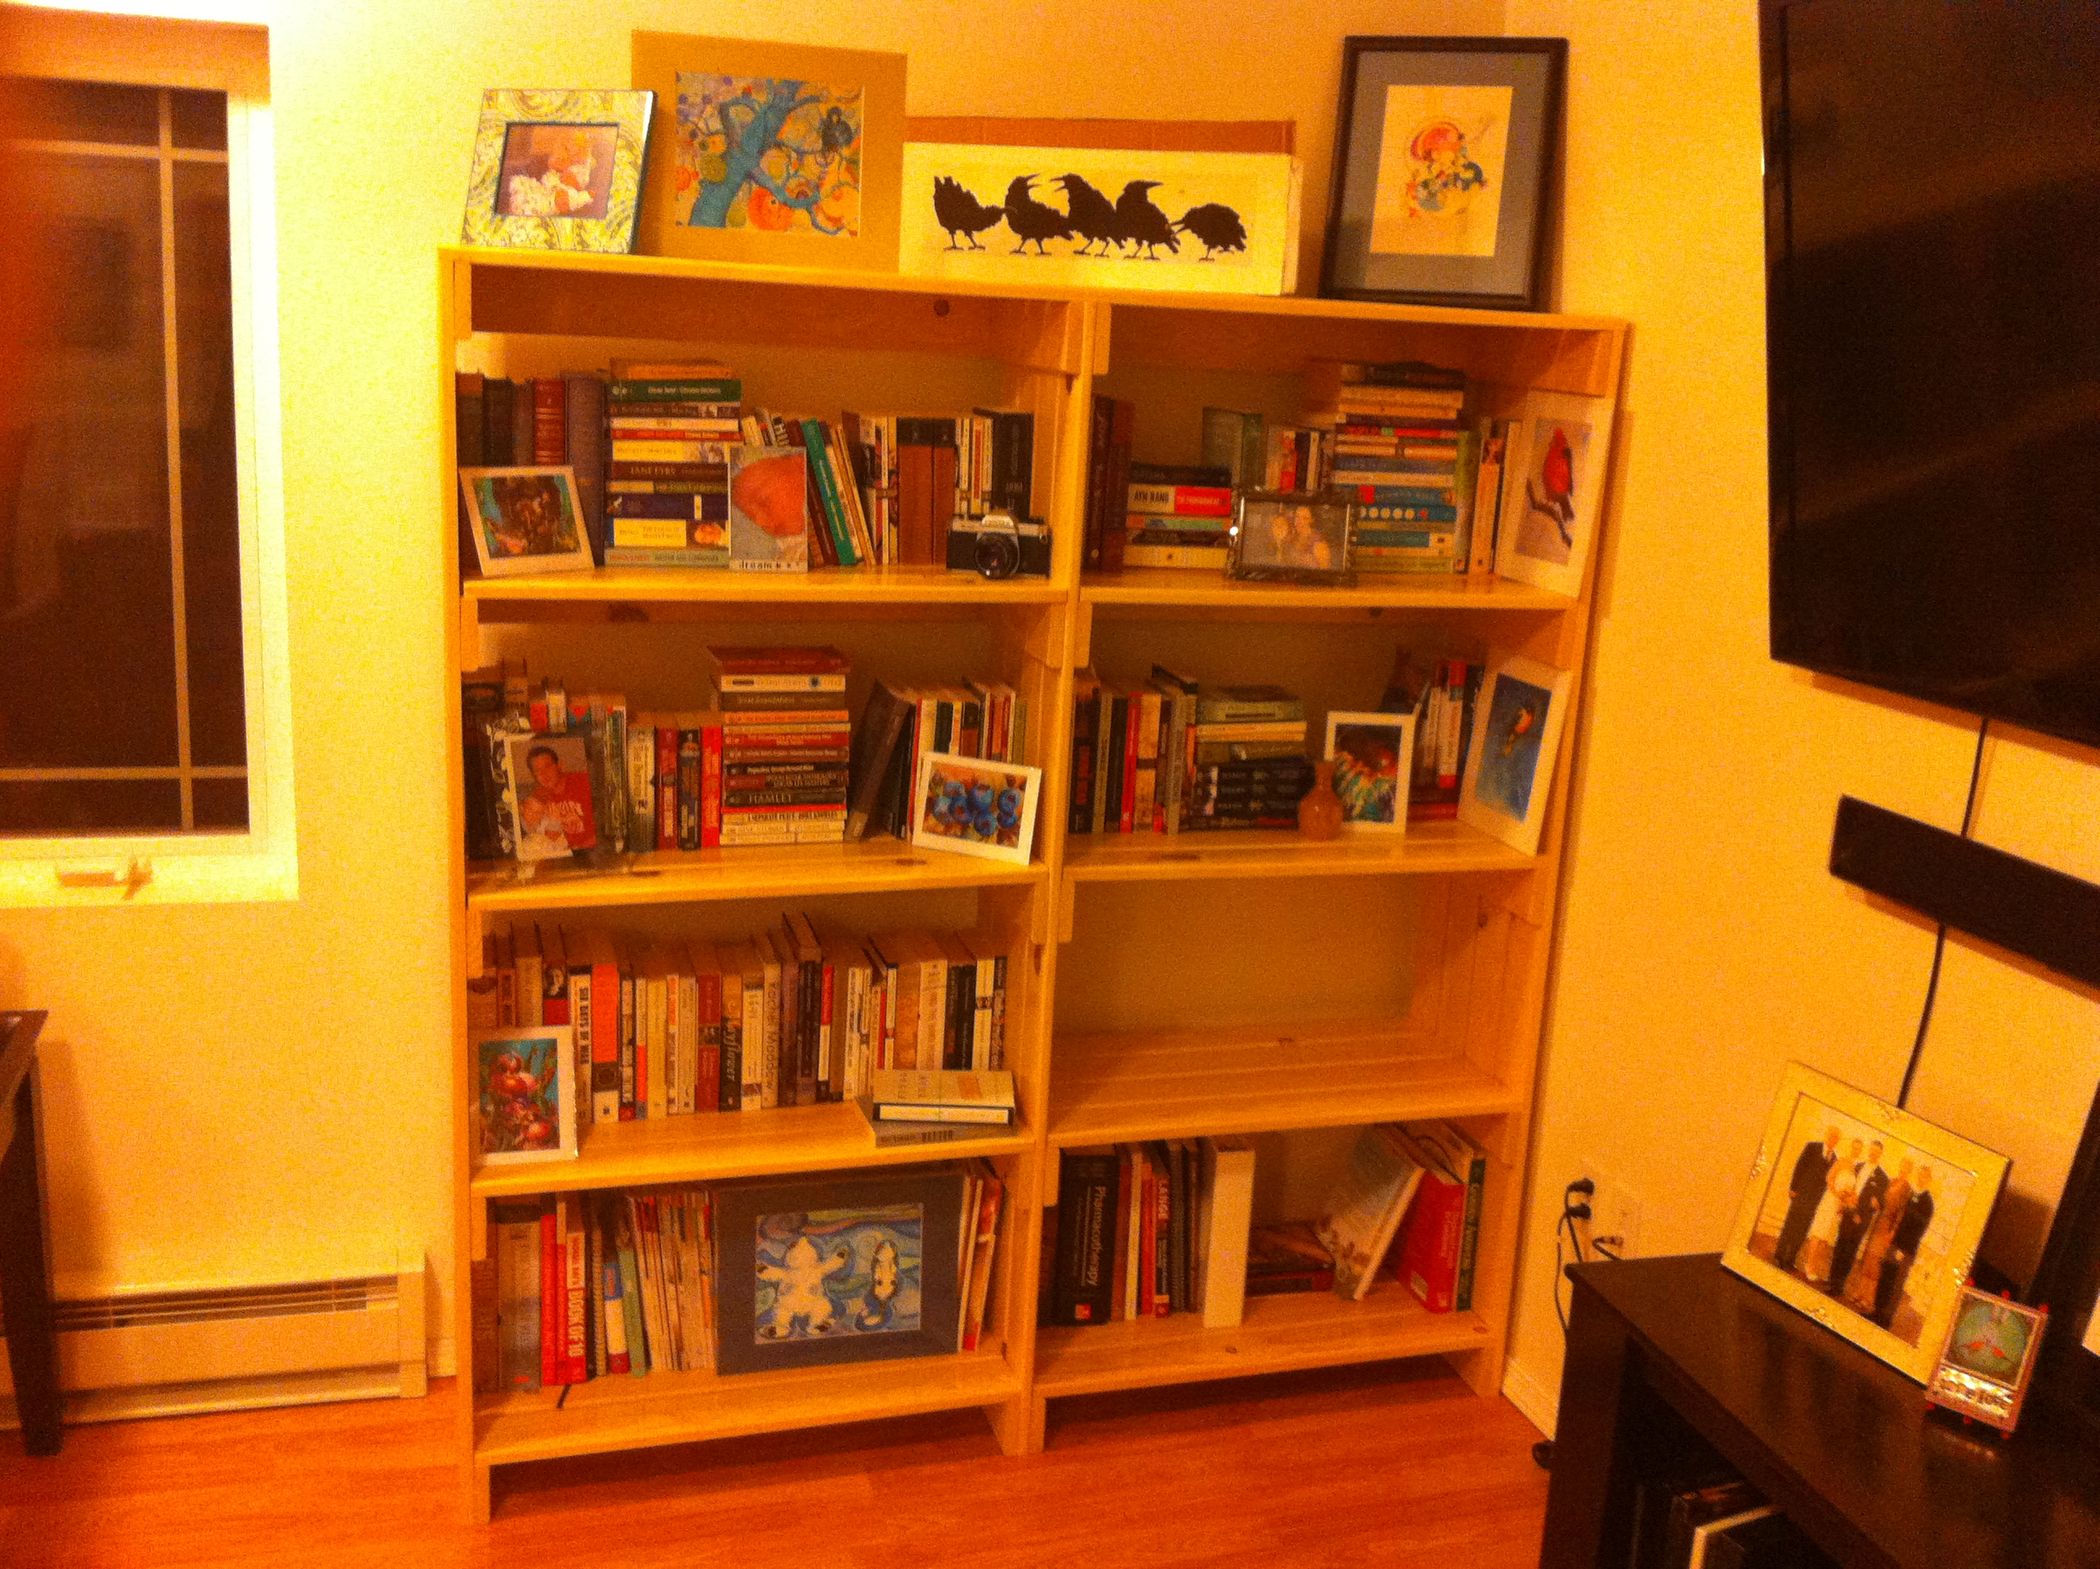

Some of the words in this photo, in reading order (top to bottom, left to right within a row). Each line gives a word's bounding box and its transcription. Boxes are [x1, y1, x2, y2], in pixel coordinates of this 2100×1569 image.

[1134, 490, 1148, 502] AYN
[1150, 491, 1169, 503] RAND
[748, 792, 792, 804] HAMLET
[1087, 1185, 1107, 1287] Pharmacotherapy
[568, 1290, 585, 1324] BOOK
